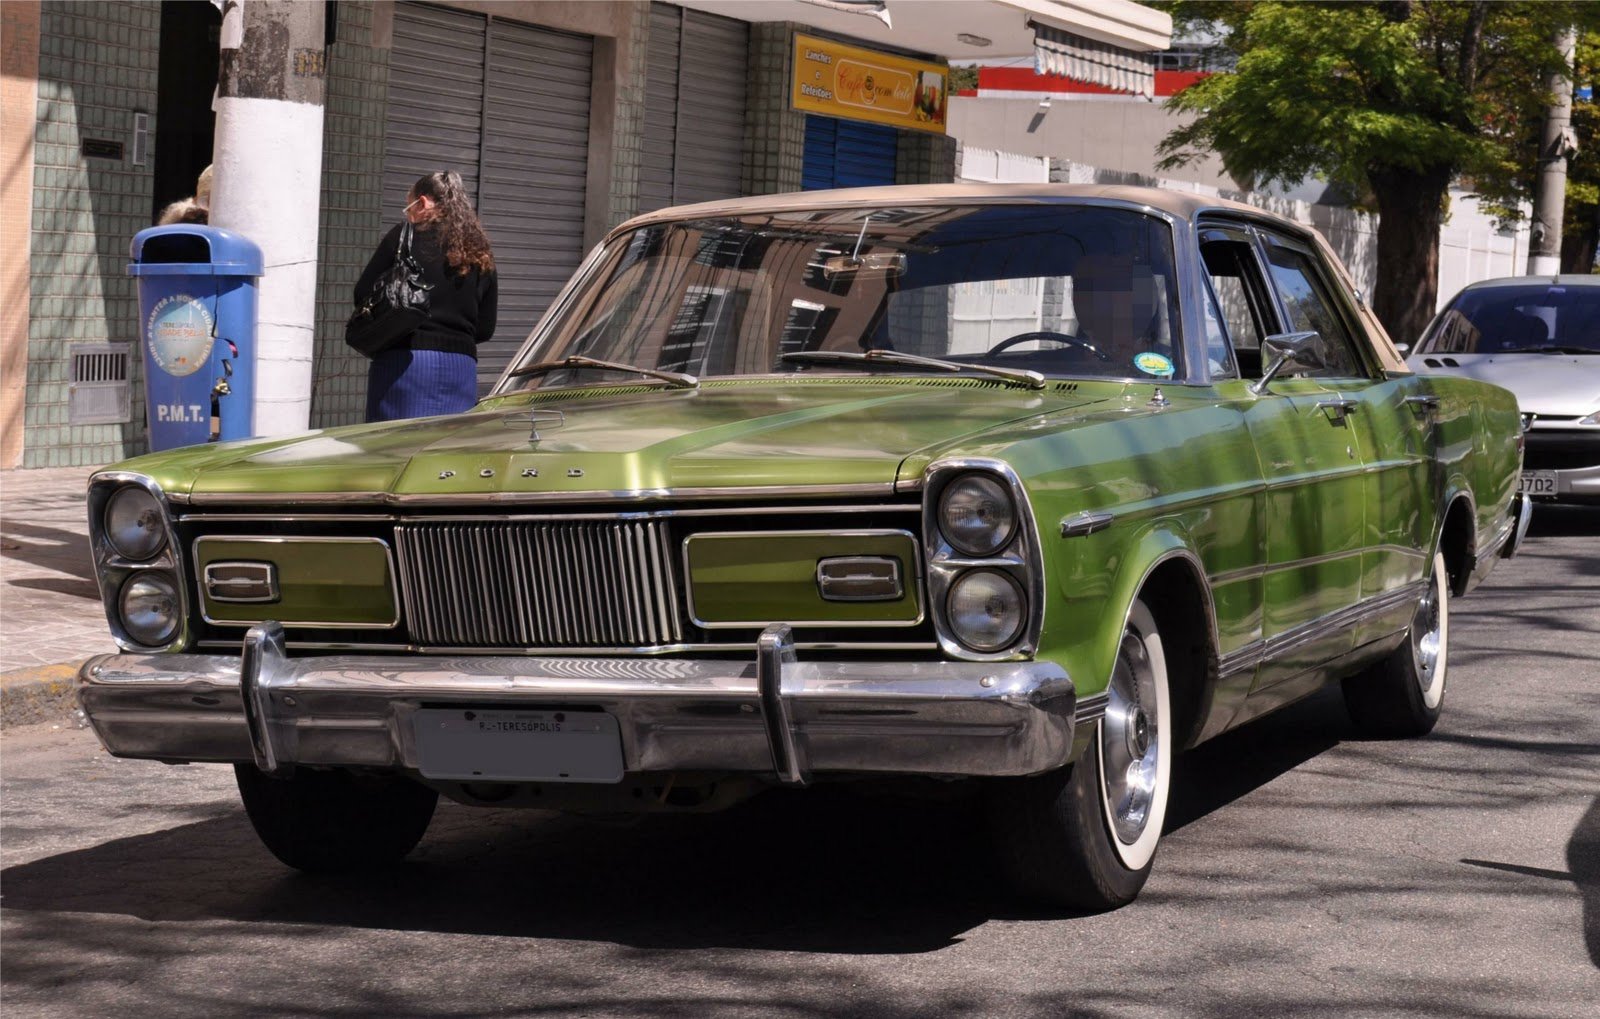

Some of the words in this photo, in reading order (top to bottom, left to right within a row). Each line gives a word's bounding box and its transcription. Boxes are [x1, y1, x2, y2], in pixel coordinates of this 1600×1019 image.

[805, 49, 832, 64] Lanches
[815, 71, 821, 79] e
[148, 297, 168, 330] MANTER
[157, 404, 204, 422] P.M.T.
[439, 467, 584, 480] FORD
[479, 720, 561, 733] R-TERESÓPOLIS
